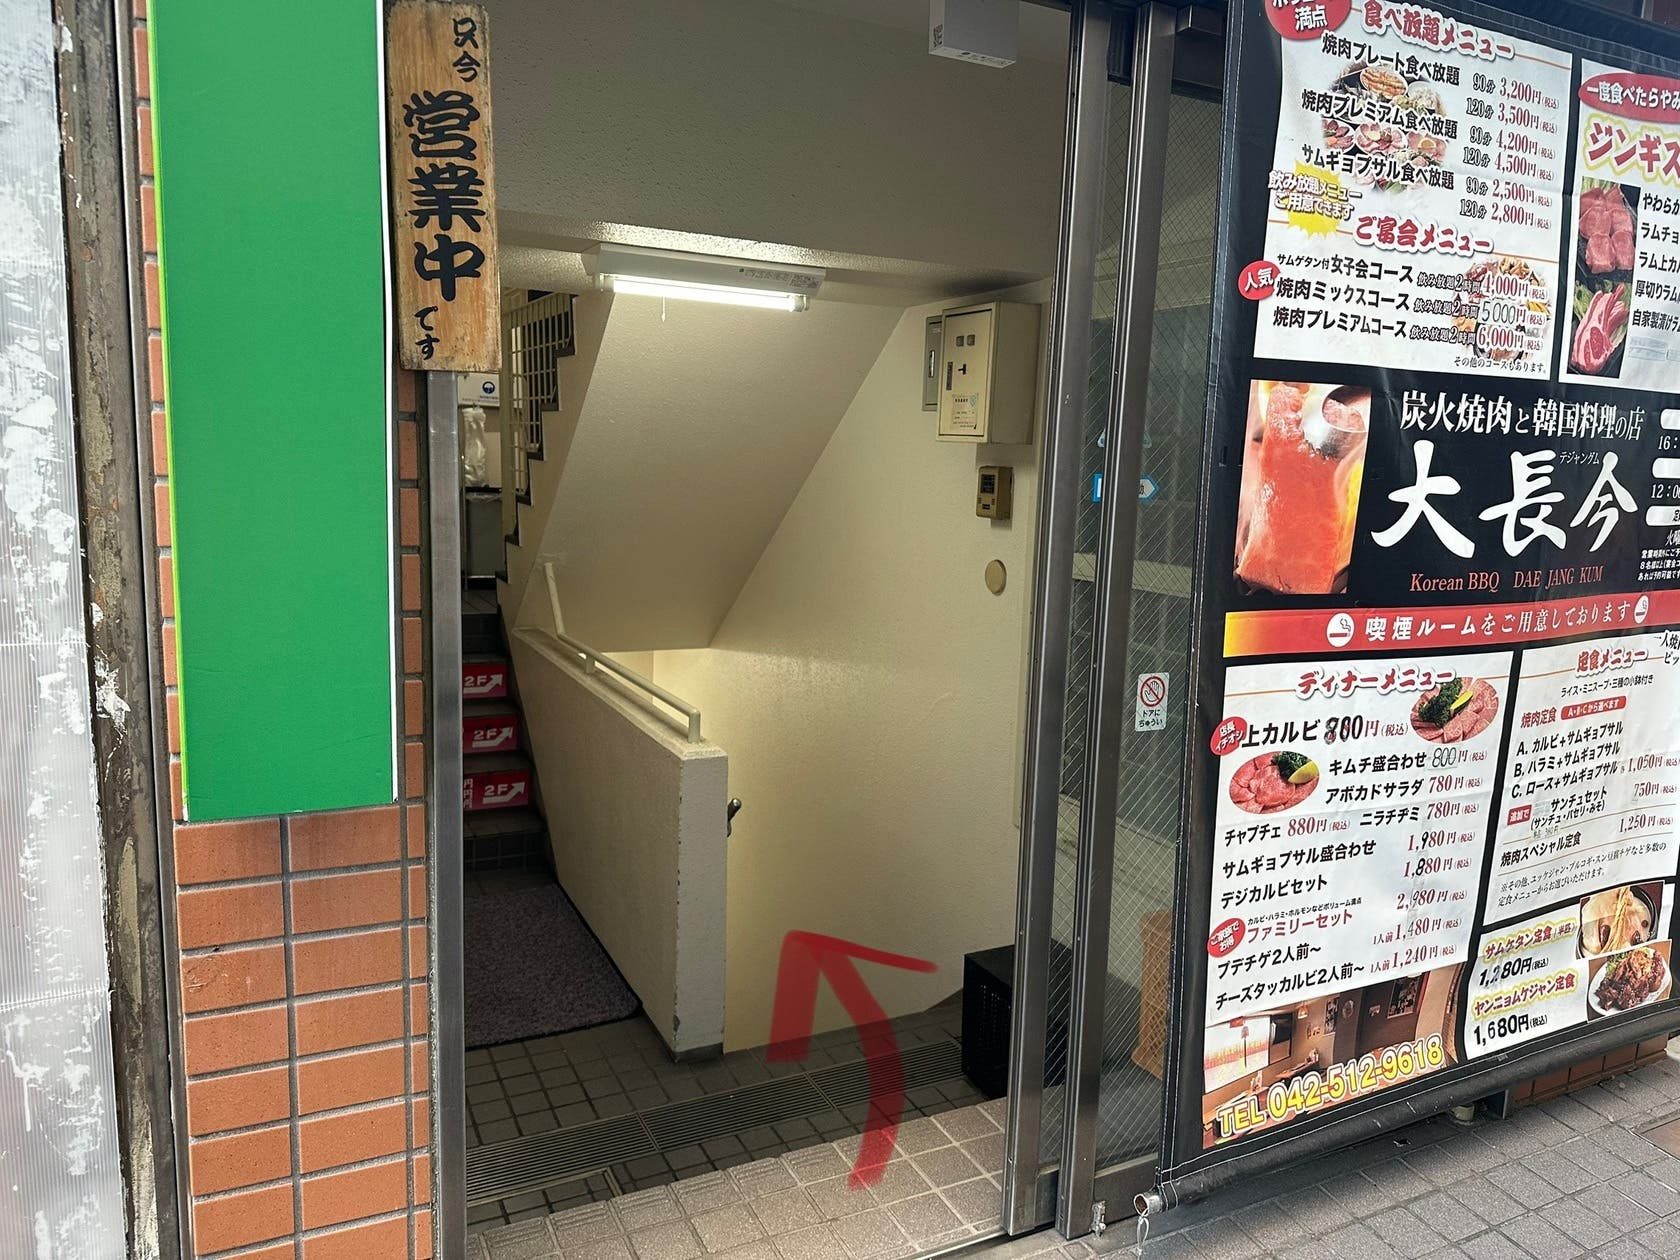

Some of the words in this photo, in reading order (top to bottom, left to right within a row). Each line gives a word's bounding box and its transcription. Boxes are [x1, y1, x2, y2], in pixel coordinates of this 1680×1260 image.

[1295, 5, 1327, 31] 満点
[1364, 0, 1511, 55] 食べ放題メニュー
[452, 17, 481, 82] 只今
[1321, 33, 1460, 86] 焼肉プレート食べ放題
[1473, 73, 1496, 94] 90分
[1301, 89, 1458, 139] 焼肉プレミアム食べ放題
[1466, 98, 1494, 119] 120分
[1470, 126, 1492, 146] 90分
[1589, 122, 1680, 178] ジンギス
[1302, 145, 1454, 190] サムギョプサル食べ放題
[1463, 147, 1490, 168] 120分
[403, 90, 485, 302] 営業中
[1268, 171, 1362, 201] 飲み放題メニュー
[1466, 176, 1489, 196] 90分
[1274, 192, 1354, 220] ご用意できます
[1460, 199, 1487, 219] 120分
[1357, 216, 1491, 251] ご宴会メニュー
[1244, 266, 1274, 291] 人気
[1635, 279, 1680, 304] 厚切りラム
[1276, 277, 1410, 311] 焼肉ミックスコース
[413, 305, 439, 361] です
[1273, 305, 1407, 338] 焼肉プレミアムコース
[1400, 390, 1646, 441] 炭火焼肉と韓国料理の店
[1370, 439, 1639, 558] 大長今
[1409, 573, 1464, 592] Korean
[1468, 571, 1500, 593] BBQ
[1513, 571, 1541, 589] DAE
[1545, 567, 1574, 590] JANG
[1579, 565, 1604, 584] KUM
[1365, 601, 1631, 641] 喫煙ルームをご用意しております
[1653, 633, 1680, 650] 一人焼
[1577, 648, 1646, 672] 定食メニュー
[464, 675, 487, 686] 2F
[1298, 668, 1453, 693] ディナーメニュー
[1220, 720, 1235, 737] 店長
[1521, 707, 1557, 728] 焼肉定食
[474, 728, 497, 740] 2F
[1242, 717, 1321, 748] 上カルビ
[1328, 751, 1427, 776] キムチ盛合わせ
[484, 784, 508, 796] 2F
[1325, 778, 1424, 804] アボカドサラダ
[1551, 785, 1608, 811] サンチュセット
[1360, 806, 1420, 827] ニラチヂミ
[1224, 823, 1281, 847] チャプチェ
[1500, 831, 1582, 867] 焼肉スペシャル定食
[1222, 839, 1377, 879] サムギョプサル盛合わせ
[1221, 874, 1328, 910] デジカルビセット
[1247, 909, 1353, 944] ファミリーセット
[1217, 1098, 1265, 1136] TEL
[1270, 1035, 1444, 1119] 042-512-9618
